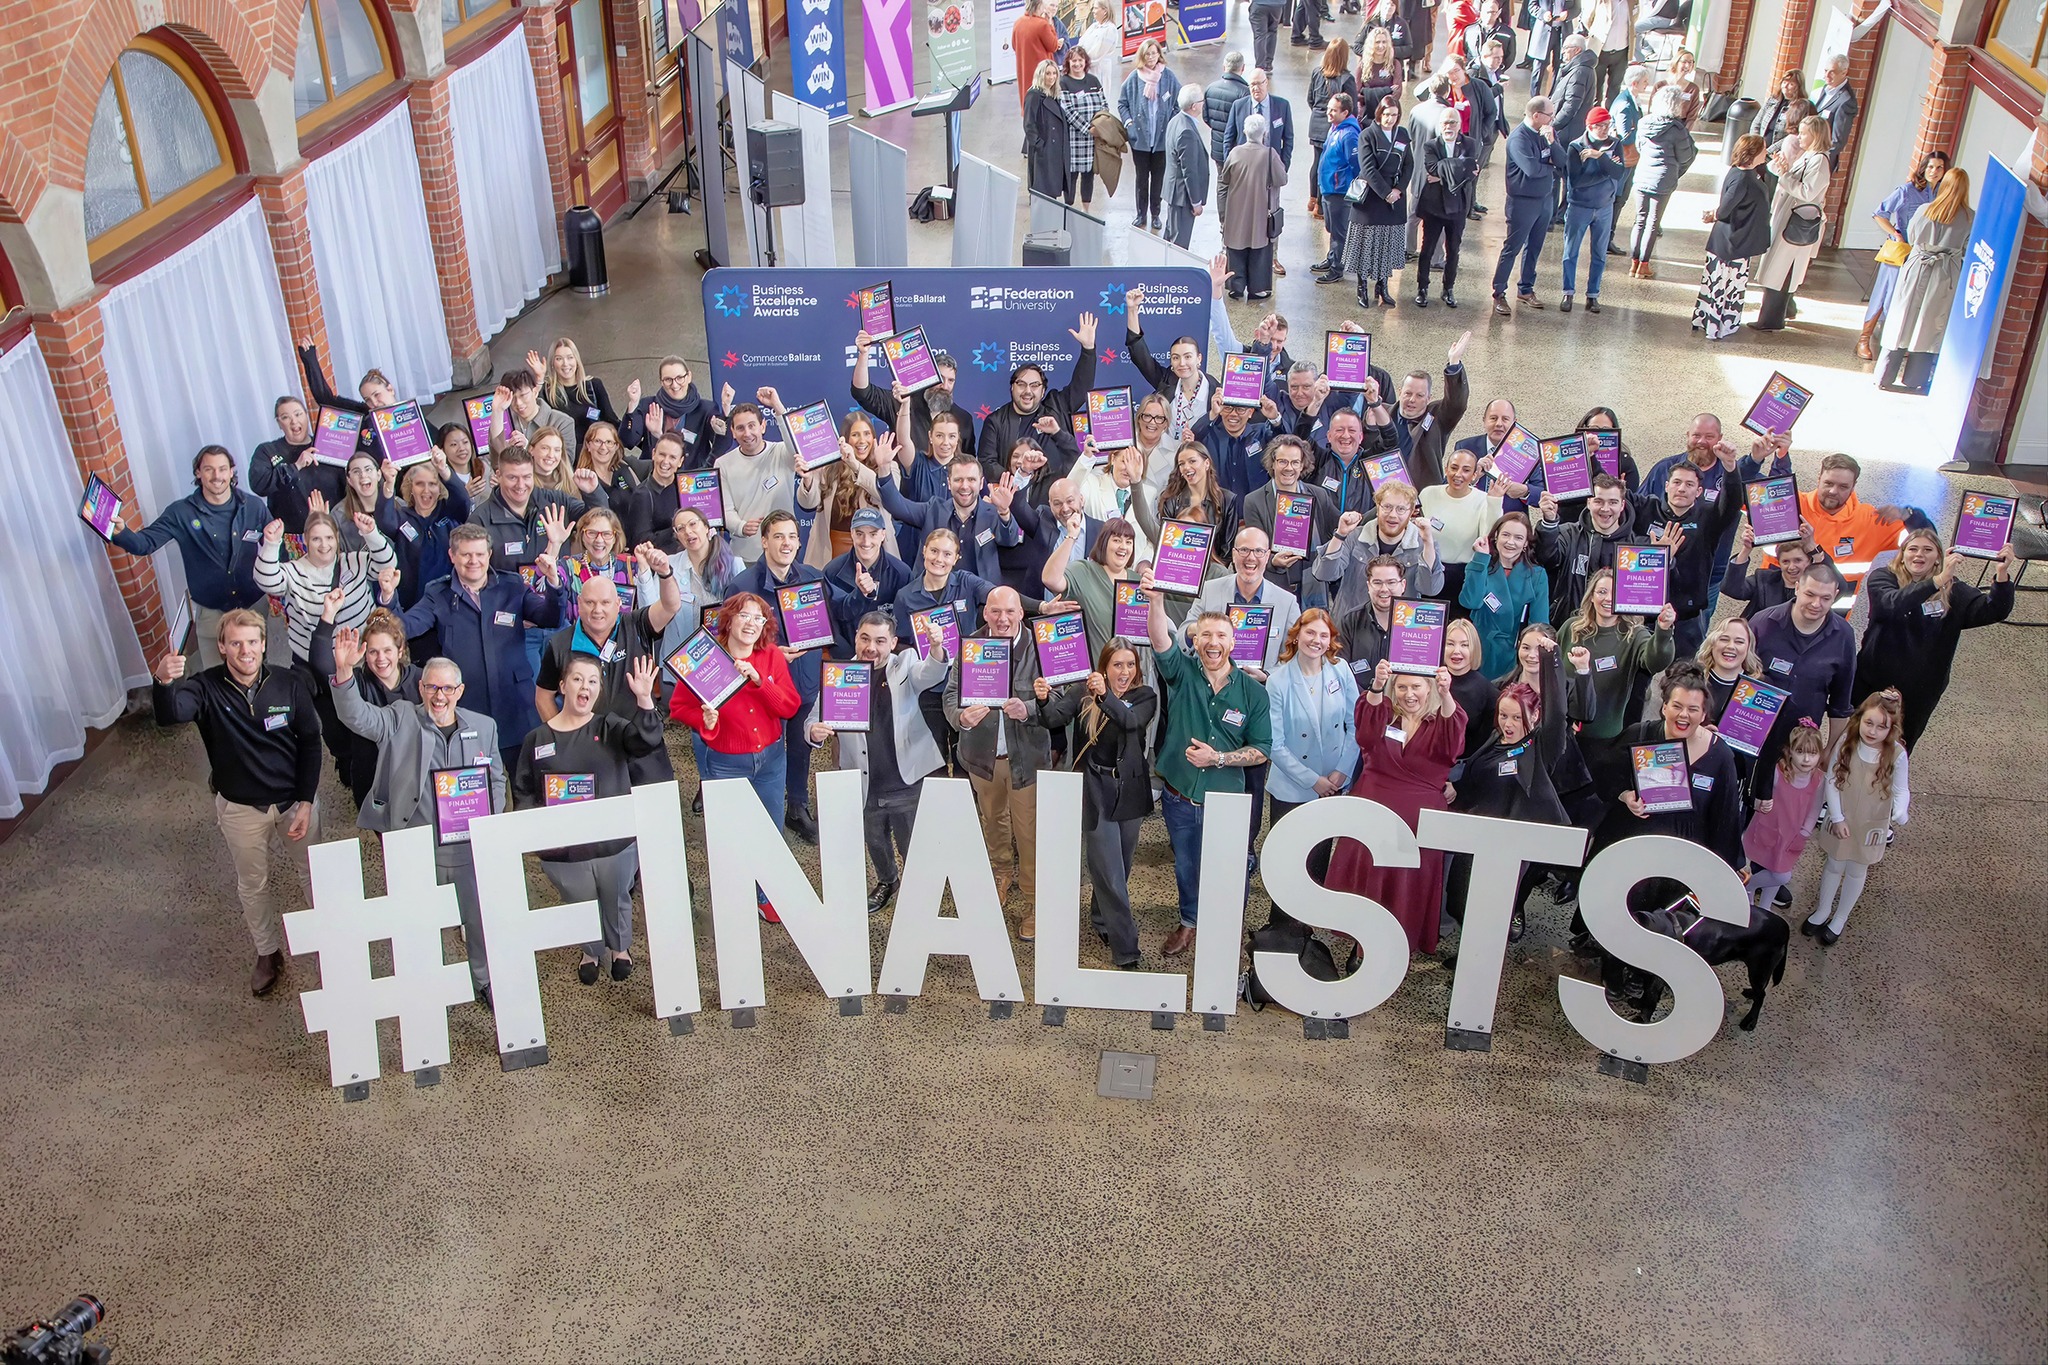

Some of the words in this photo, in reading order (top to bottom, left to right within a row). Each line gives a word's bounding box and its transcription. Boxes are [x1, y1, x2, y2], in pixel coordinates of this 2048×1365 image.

[810, 33, 828, 45] WIN
[812, 72, 829, 84] WIN
[753, 284, 804, 295] Business
[1004, 288, 1074, 299] Federation
[1138, 283, 1188, 294] Business
[753, 296, 818, 306] Excellence
[894, 294, 946, 303] erceBallarat
[754, 306, 799, 317] Awards
[1004, 300, 1056, 312] University
[1138, 305, 1182, 315] Awards
[1010, 342, 1060, 351] Business
[900, 354, 922, 366] FINALIST
[1010, 352, 1072, 361] Excellence
[1767, 400, 1789, 416] FINALIST
[325, 432, 350, 442] FINALIST
[390, 428, 415, 439] FINALIST
[803, 429, 826, 440] FINALIST
[1508, 449, 1527, 463] FINALIST
[1553, 463, 1579, 472] FINALIST
[1759, 504, 1787, 514] FINALIST
[1970, 520, 1999, 528] FINALIST
[1168, 552, 1197, 561] FINALIST
[793, 610, 819, 619] FINALIST
[1401, 632, 1432, 640] FINALIST
[1048, 642, 1077, 653] FINALIST
[695, 659, 718, 680] FINALIST
[1735, 708, 1764, 722] FINALIST
[448, 798, 479, 807] FINALIST
[283, 770, 1751, 1088] #FINALISTS
